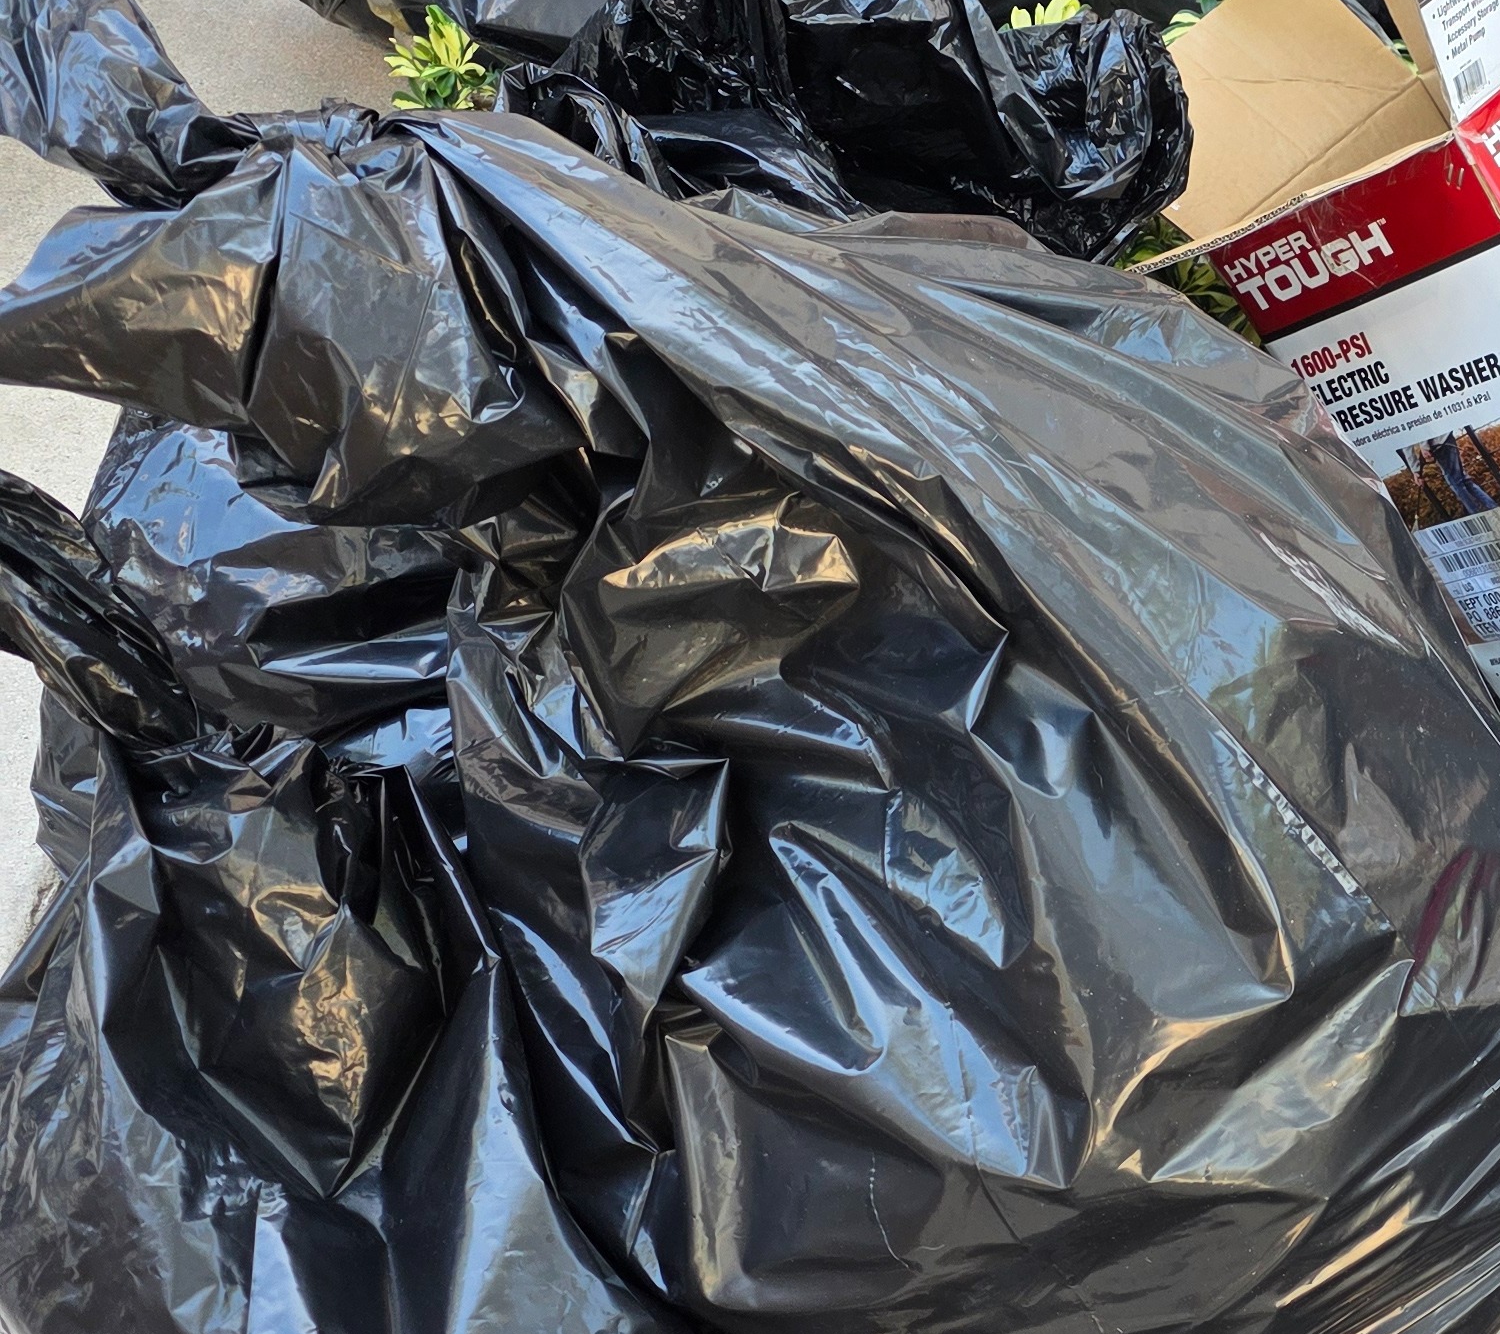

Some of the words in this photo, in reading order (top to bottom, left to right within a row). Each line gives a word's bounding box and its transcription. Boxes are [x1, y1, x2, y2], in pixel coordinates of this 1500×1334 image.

[1442, 3, 1471, 31] Transport
[1447, 16, 1476, 45] Accessory
[1478, 0, 1499, 21] Storage
[1451, 42, 1468, 58] Metal
[1469, 27, 1486, 45] Pump
[1224, 231, 1312, 283] HYPER
[1236, 221, 1394, 311] TOUGH
[1291, 332, 1373, 380] 1600-PSI
[1372, 424, 1400, 441] eléctrica
[1407, 414, 1432, 431] presión
[1432, 409, 1443, 421] de
[1443, 399, 1473, 416] 11031.6
[1458, 595, 1483, 612] DEPT
[1466, 609, 1482, 624] PO
[1473, 623, 1498, 637] ITEM
